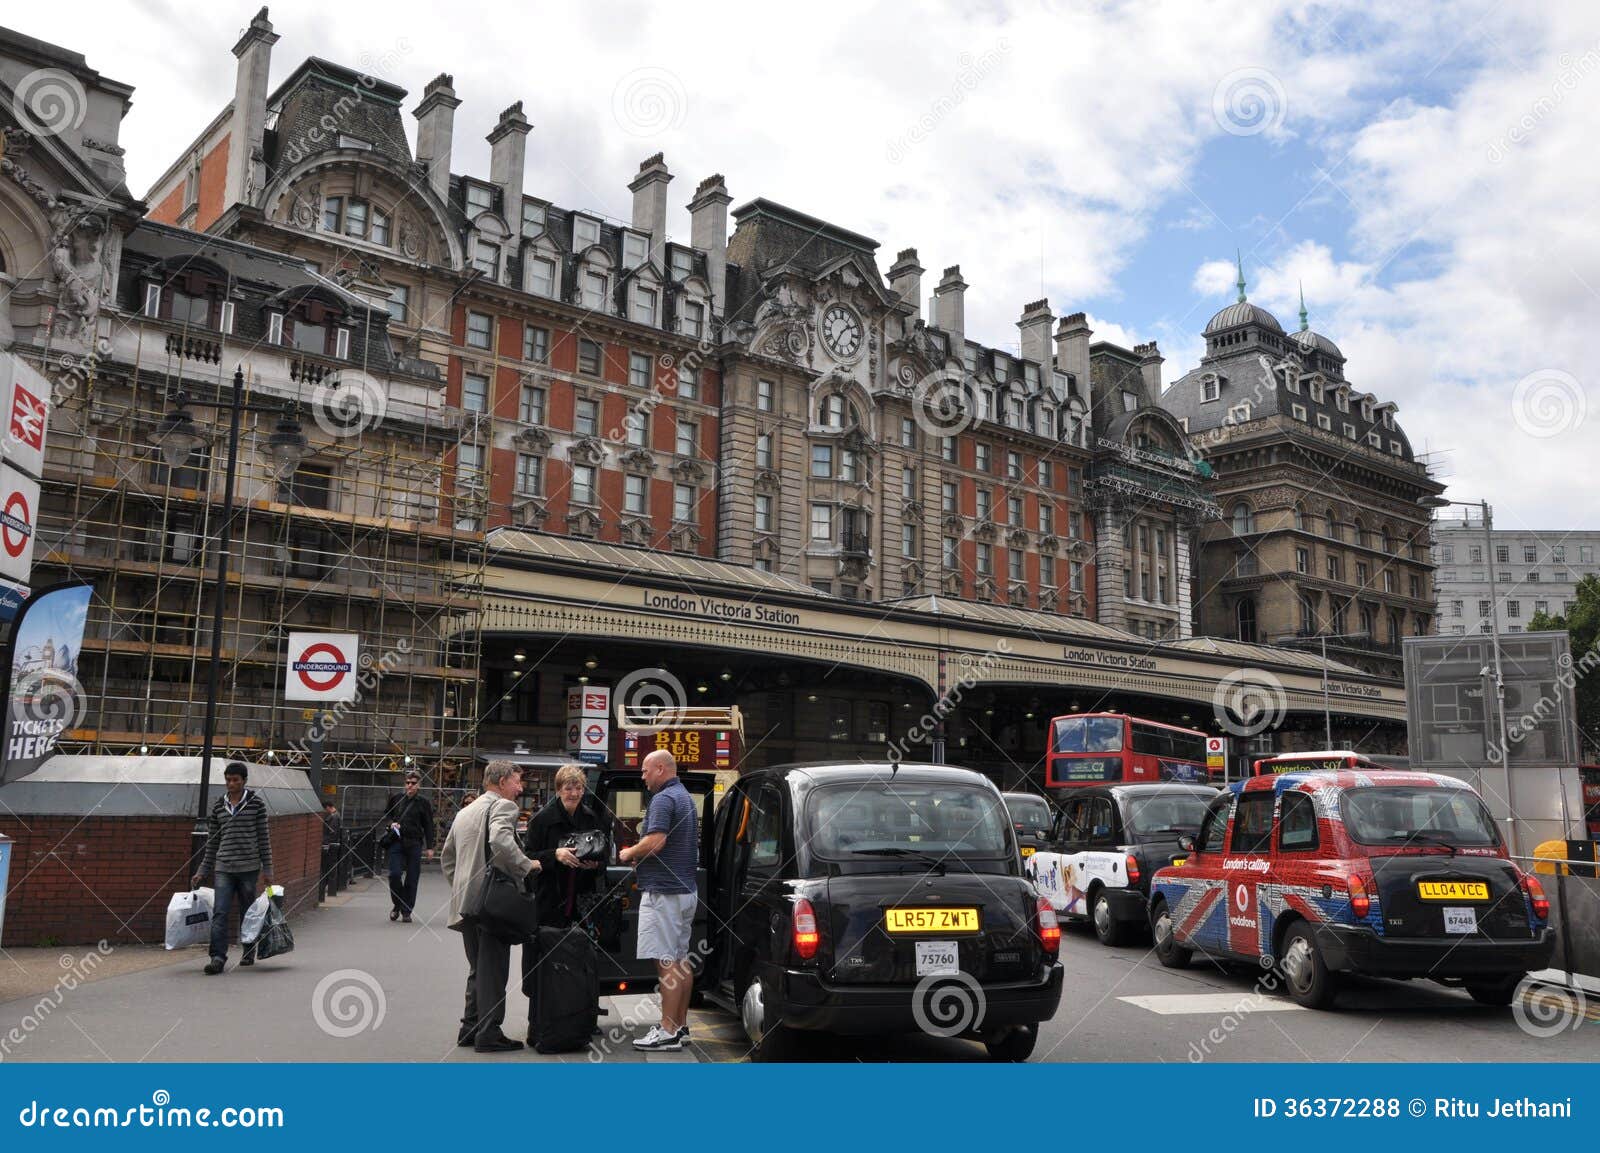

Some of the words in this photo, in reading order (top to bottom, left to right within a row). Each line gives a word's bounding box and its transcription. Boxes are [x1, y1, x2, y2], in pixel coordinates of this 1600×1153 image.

[644, 590, 696, 612] London
[700, 598, 751, 618] Victoria
[755, 605, 800, 625] Station
[1063, 647, 1095, 662] London
[1096, 651, 1128, 667] Victoria
[1128, 655, 1157, 670] Station
[295, 663, 349, 671] UNDERGROUND
[13, 719, 64, 736] TICKETS
[655, 731, 700, 743] BIG
[8, 733, 60, 760] HERE
[1092, 762, 1104, 772] C2
[1271, 764, 1311, 774] Waterloo
[1223, 858, 1248, 870] London's
[1248, 859, 1270, 874] calling
[1424, 884, 1456, 896] LL04
[1459, 884, 1484, 896] VCC
[894, 912, 935, 927] LR57
[941, 912, 970, 927] ZWT
[1230, 916, 1257, 928] vodafone
[921, 954, 954, 965] 75760
